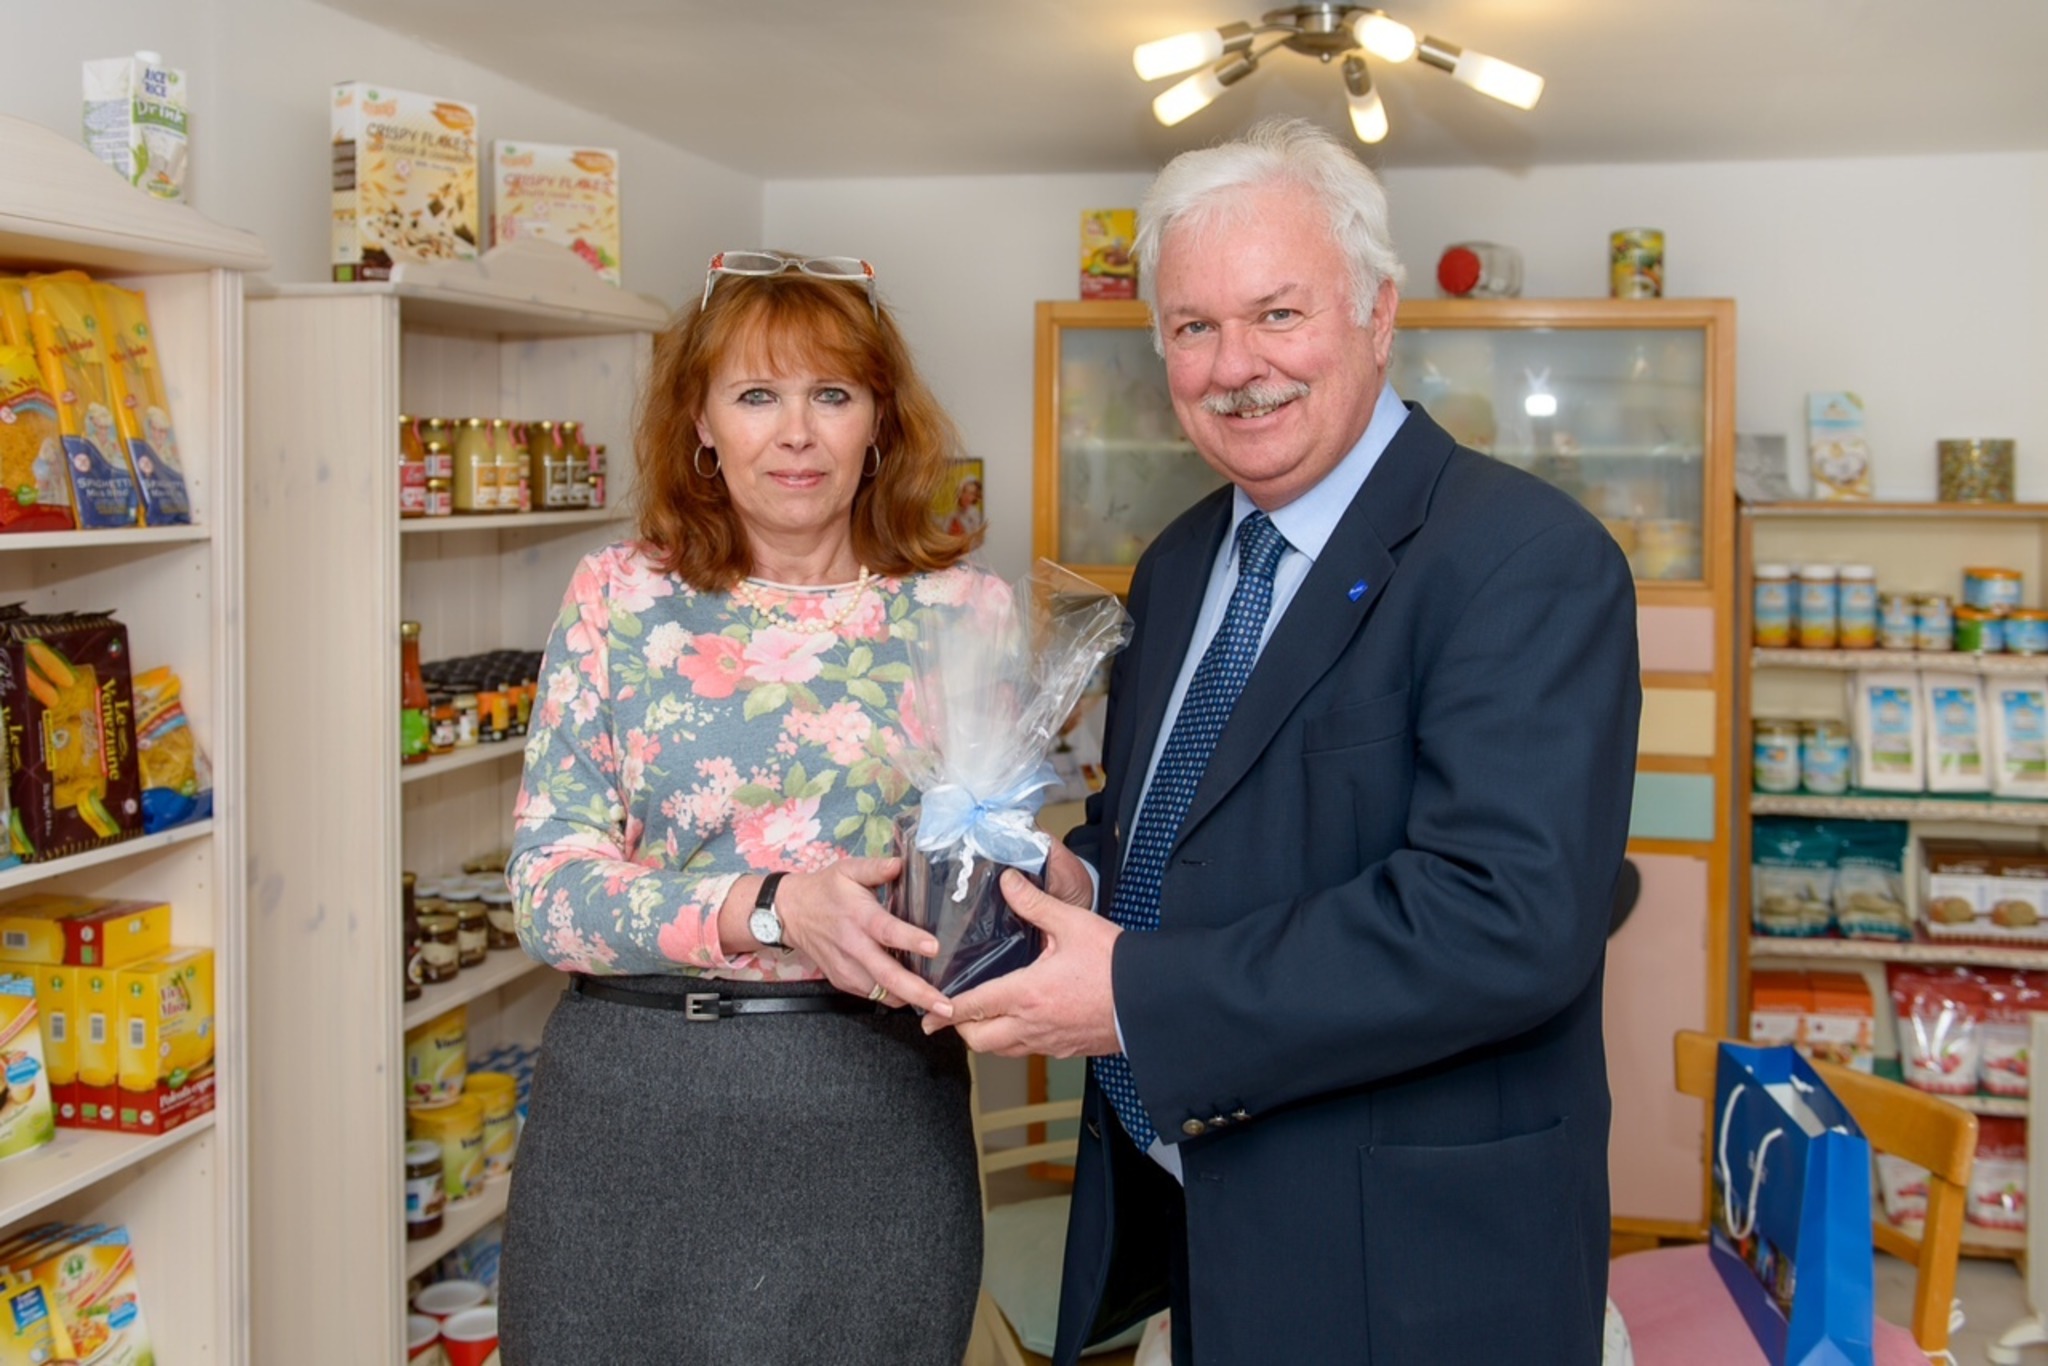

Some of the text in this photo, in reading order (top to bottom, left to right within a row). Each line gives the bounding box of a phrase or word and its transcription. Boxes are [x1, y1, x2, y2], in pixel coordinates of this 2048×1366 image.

[137, 100, 184, 122] Drink
[366, 122, 418, 142] CRISPY
[420, 130, 471, 153] FLAKES
[504, 173, 555, 187] CRISPY
[114, 700, 130, 726] Le
[9, 725, 24, 746] Le
[100, 678, 120, 781] Veneziane
